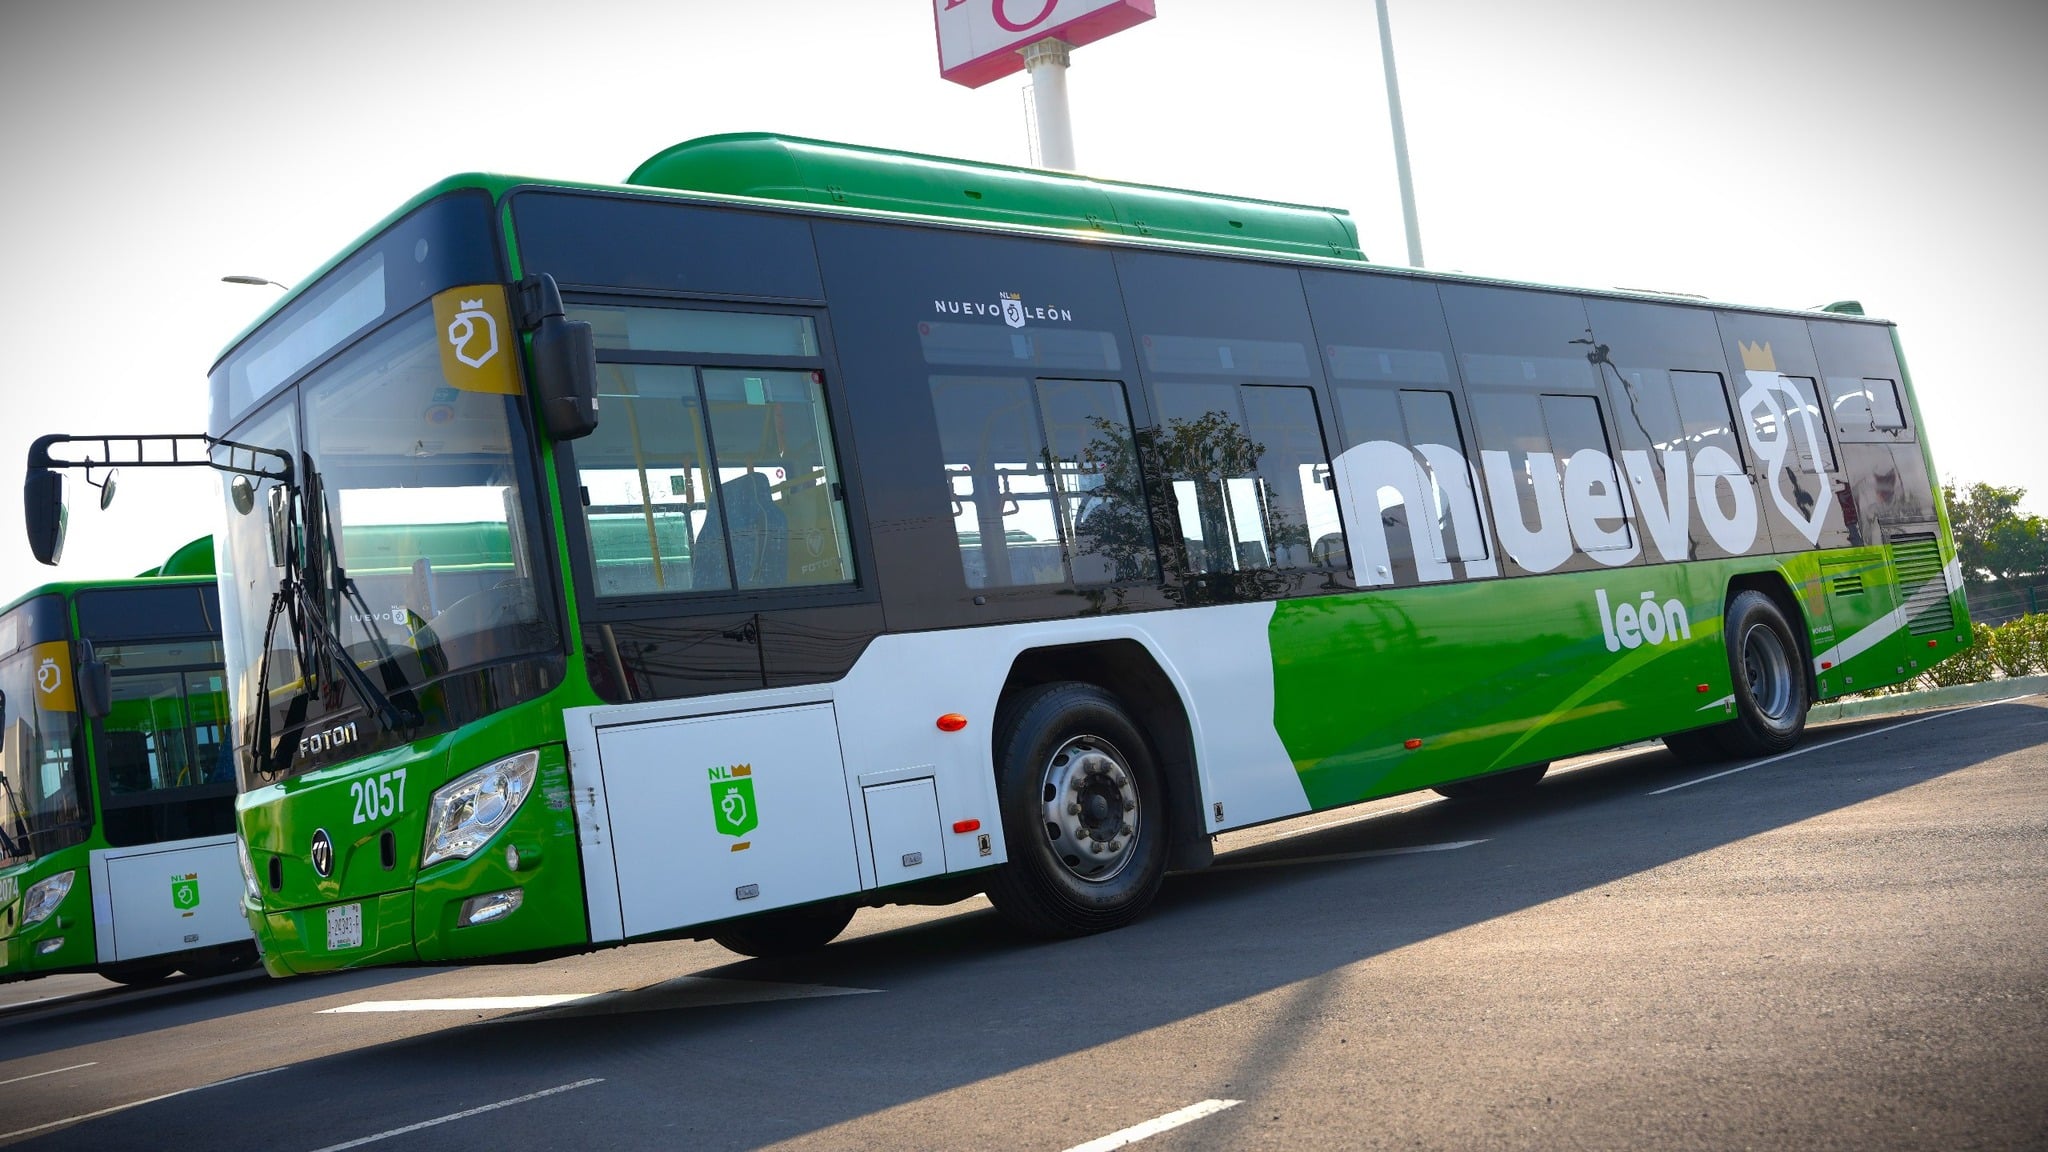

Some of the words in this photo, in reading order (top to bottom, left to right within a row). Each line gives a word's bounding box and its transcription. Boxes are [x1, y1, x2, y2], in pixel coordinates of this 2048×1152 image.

[934, 300, 1000, 316] NUEVO
[999, 291, 1011, 299] NL
[1595, 588, 1691, 652] león
[299, 721, 358, 758] FOTON
[708, 765, 731, 780] NL
[350, 767, 407, 825] 2057
